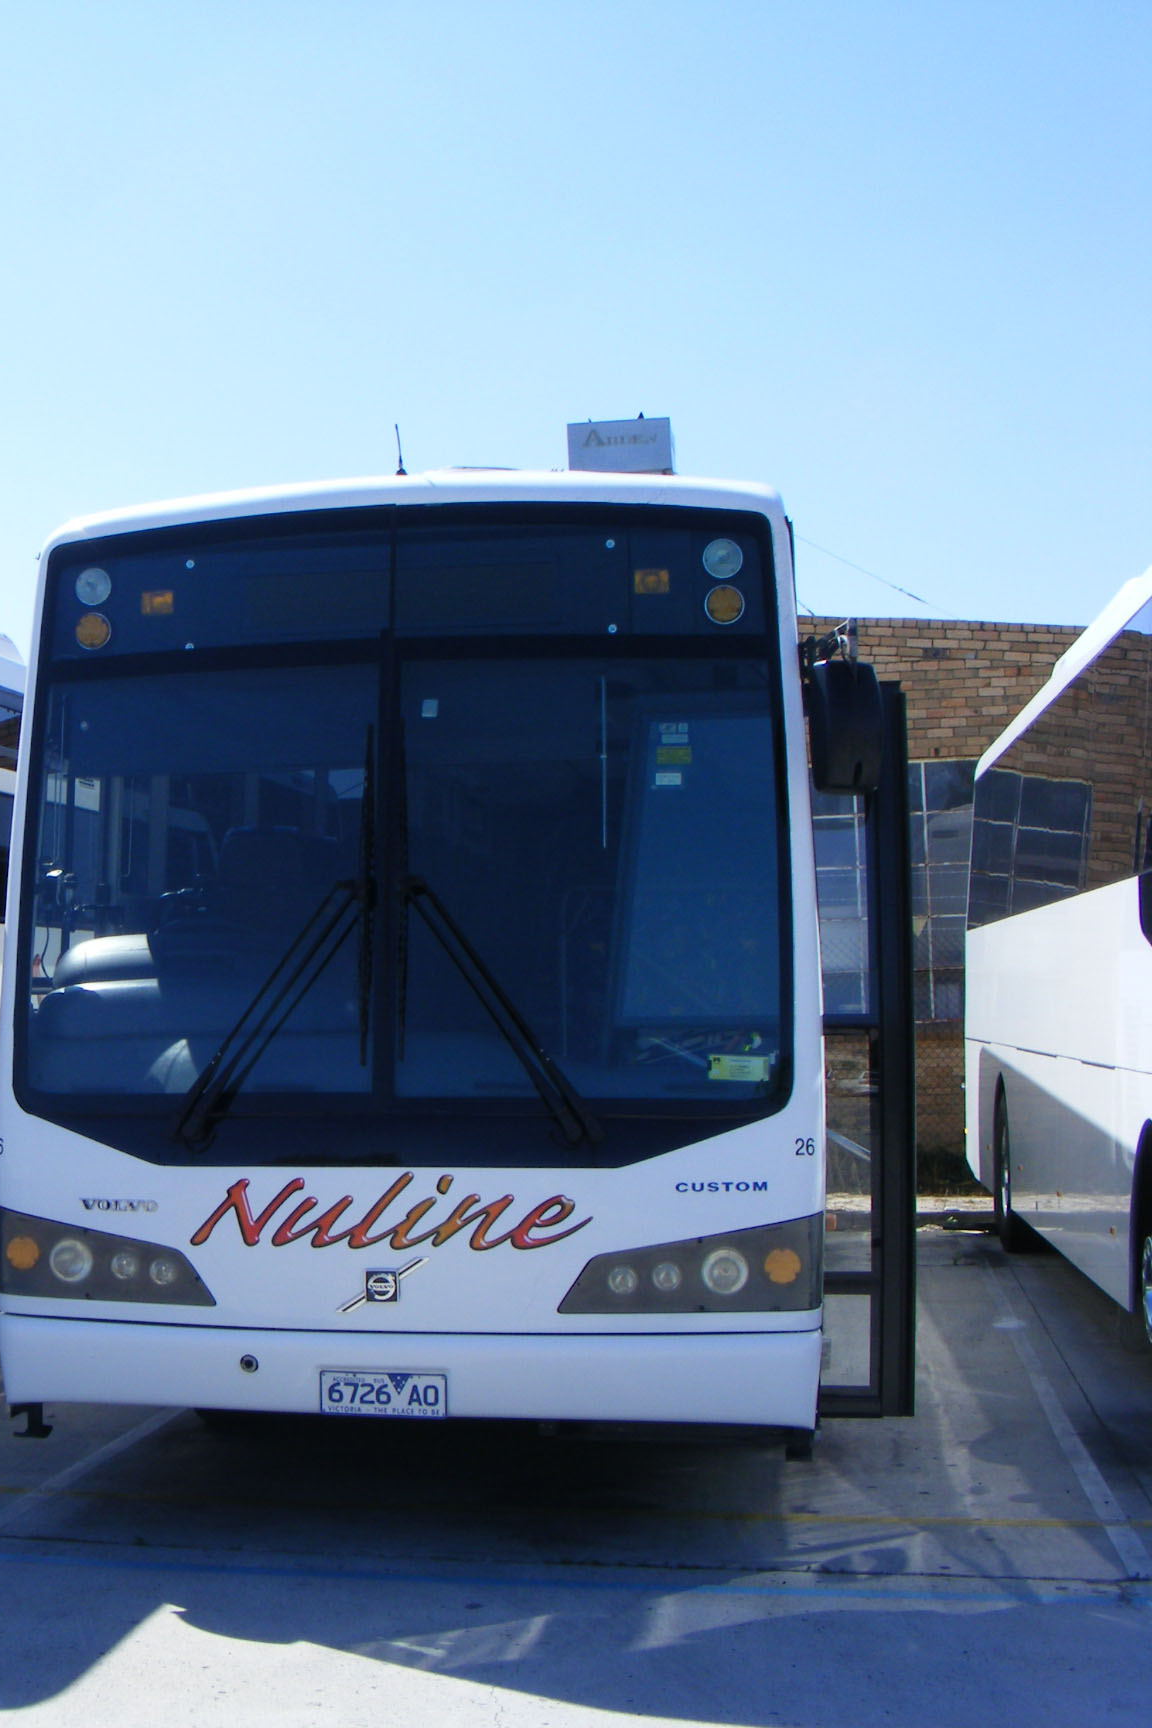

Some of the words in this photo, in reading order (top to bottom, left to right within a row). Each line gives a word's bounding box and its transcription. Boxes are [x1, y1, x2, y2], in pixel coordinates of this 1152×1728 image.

[794, 1137, 815, 1156] 26
[675, 1181, 768, 1193] CUSTOM
[80, 1198, 159, 1212] VOLVO
[189, 1170, 594, 1252] Nuline
[327, 1382, 392, 1405] 6726
[407, 1384, 439, 1407] AO
[328, 1405, 362, 1413] VICTORIA
[392, 1407, 414, 1415] PLACE
